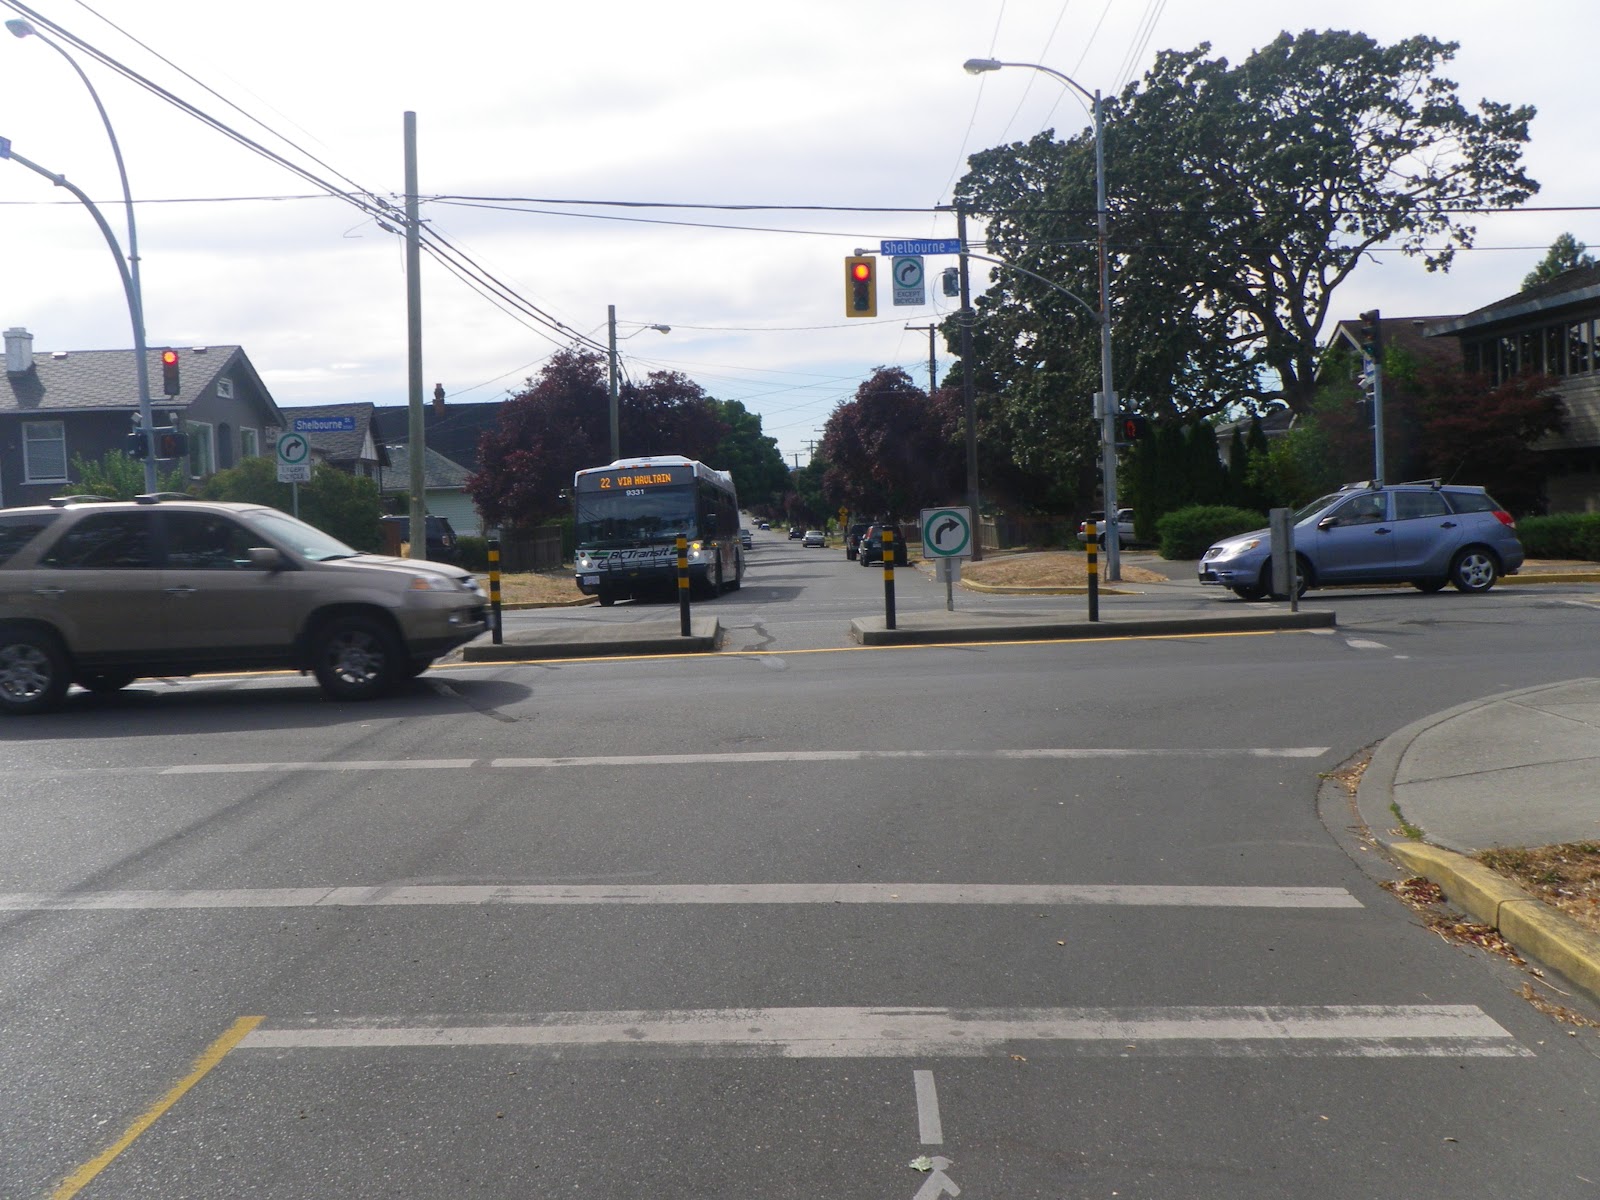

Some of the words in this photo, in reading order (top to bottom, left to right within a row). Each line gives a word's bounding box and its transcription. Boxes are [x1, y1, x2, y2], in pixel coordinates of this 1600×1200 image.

[884, 241, 945, 254] Shelbourne
[897, 290, 920, 298] EXCEPT
[296, 420, 343, 430] Shelbourne
[600, 477, 611, 488] 22
[617, 476, 632, 486] VIA
[634, 473, 671, 485] HAULTAIN
[626, 489, 645, 497] 9331
